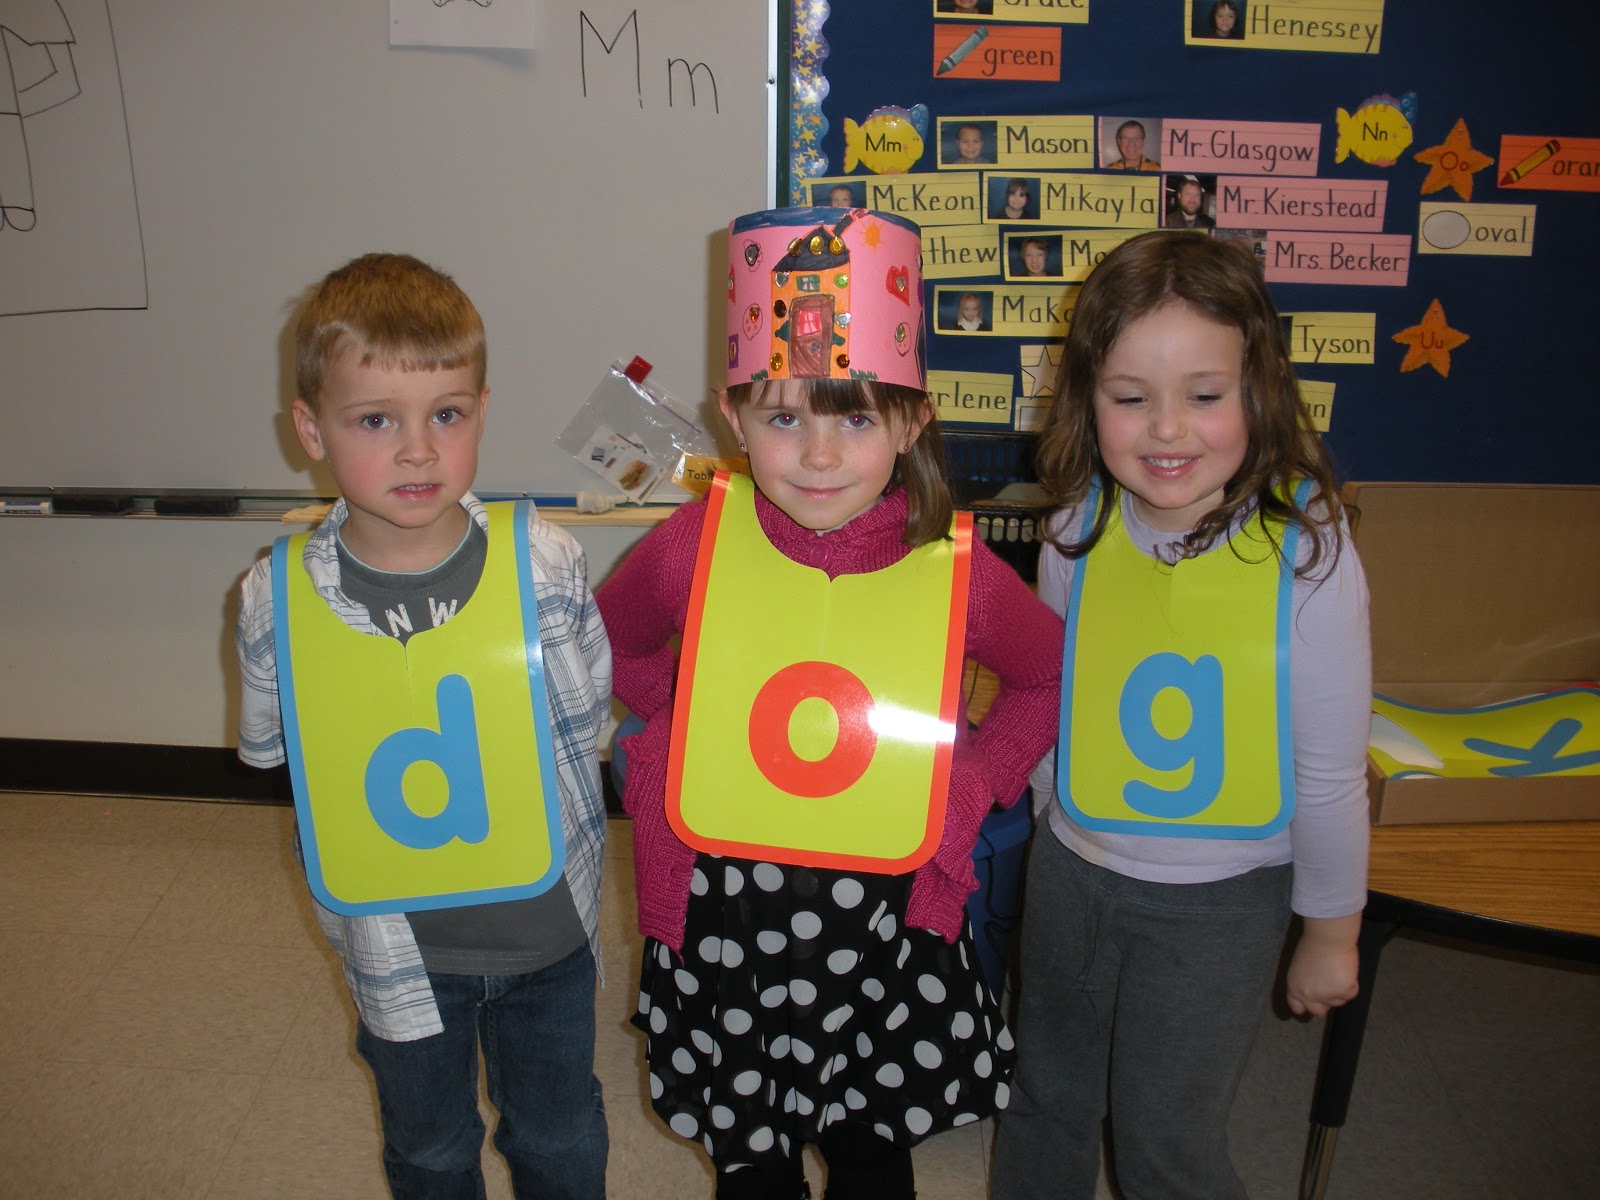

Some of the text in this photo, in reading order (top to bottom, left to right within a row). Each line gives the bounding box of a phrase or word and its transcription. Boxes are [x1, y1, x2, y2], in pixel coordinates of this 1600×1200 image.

[1251, 6, 1379, 53] Henessey
[982, 49, 1054, 76] green
[865, 133, 902, 153] Mm
[1006, 125, 1089, 154] Mason
[1362, 122, 1388, 141] Nn
[1211, 130, 1315, 171] Glasgow
[873, 183, 975, 212] McKeon
[1046, 183, 1156, 222] Mikayla
[1263, 188, 1377, 218] Kierstead
[1475, 216, 1528, 243] oval
[922, 235, 998, 264] thew
[1274, 241, 1406, 272] Mrs. Becker
[1295, 324, 1371, 363] Tyson
[1420, 332, 1444, 350] Uu
[928, 381, 1008, 410] rlene
[1118, 652, 1224, 819] g
[365, 674, 490, 850] d
